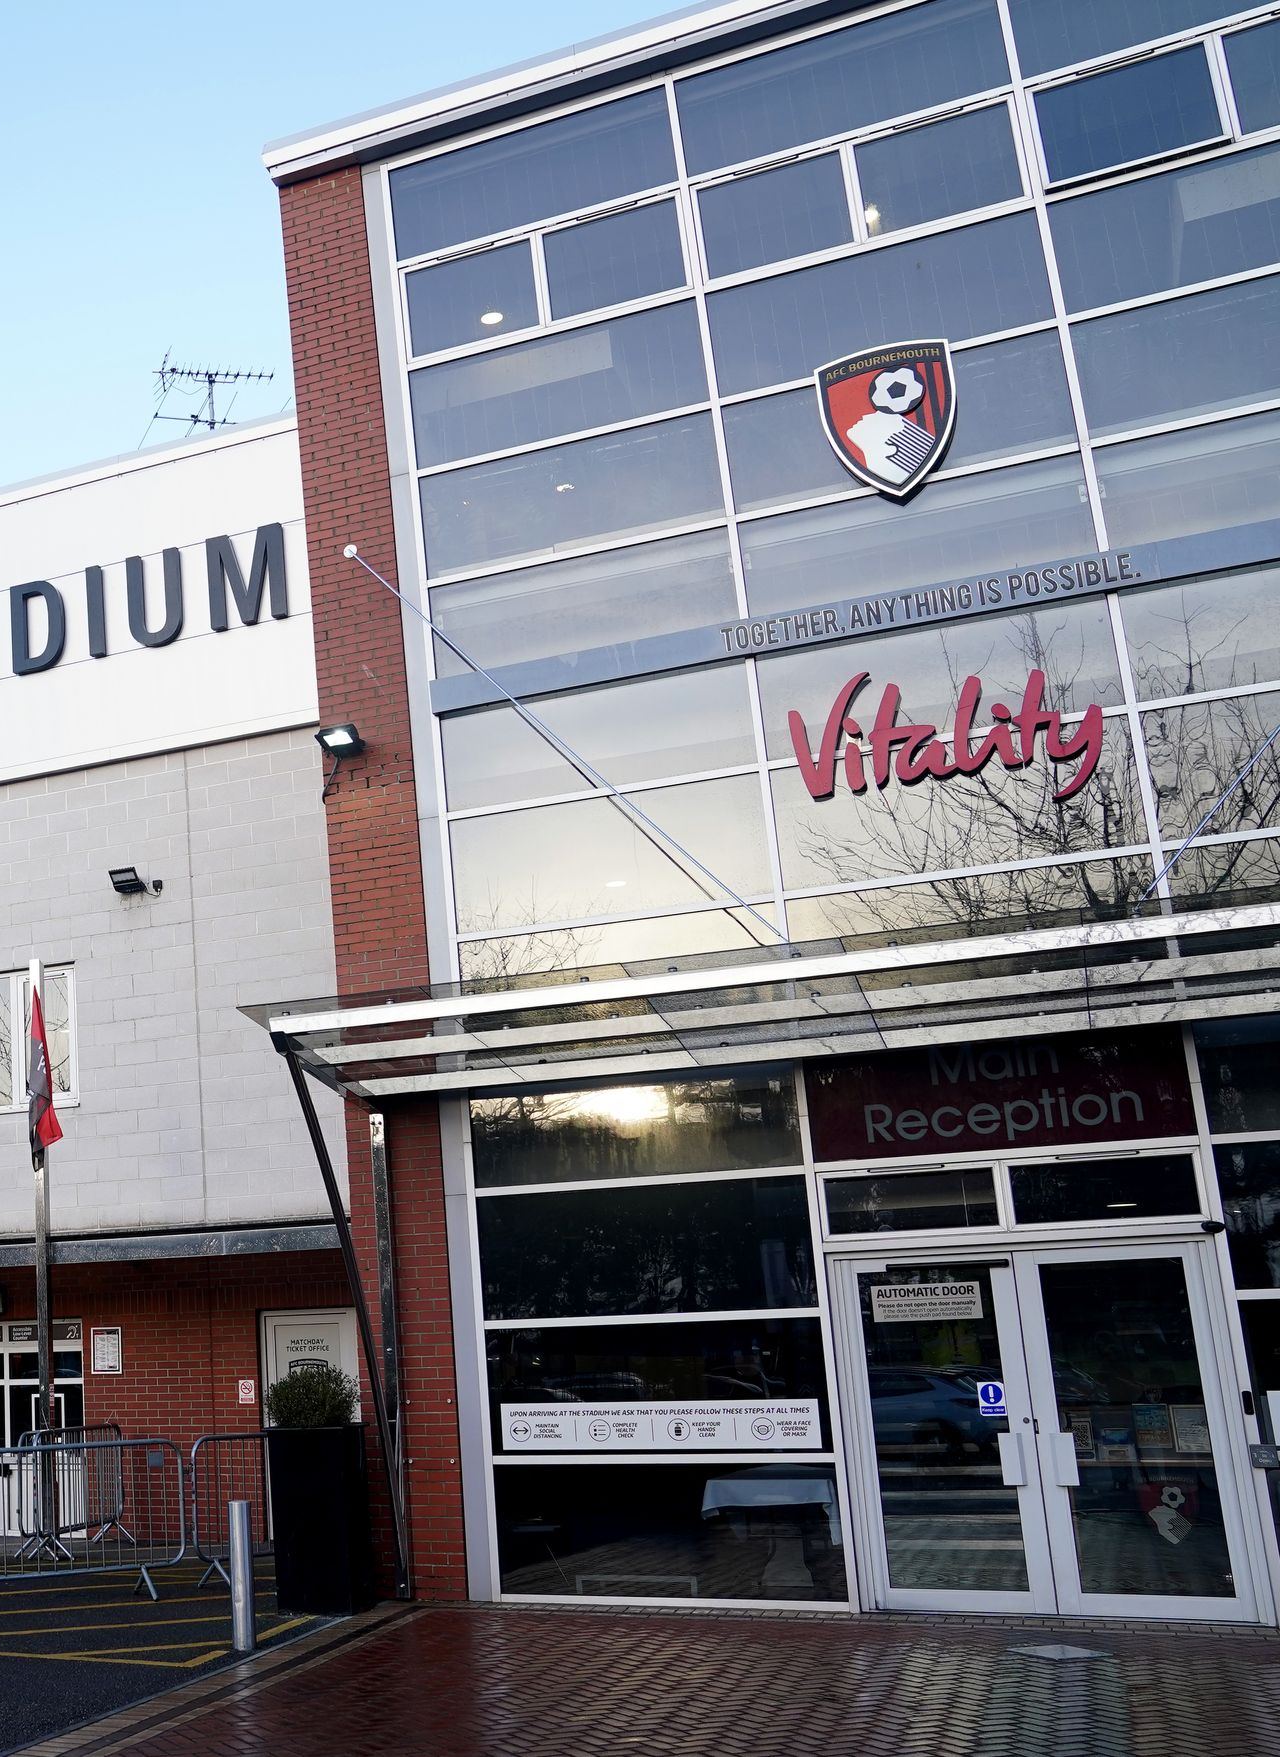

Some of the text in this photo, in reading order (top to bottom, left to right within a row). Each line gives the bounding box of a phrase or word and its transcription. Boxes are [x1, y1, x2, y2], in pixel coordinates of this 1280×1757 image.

[826, 347, 940, 381] AFC BOURNEMOUTH
[719, 553, 1142, 654] TOGETHER, ANYTHING IS POSSIBLE.
[787, 668, 1104, 803] Vitality
[928, 1041, 1060, 1086] Main
[863, 1086, 1145, 1144] Reception
[876, 1285, 975, 1299] AUTOMATIC DOOR
